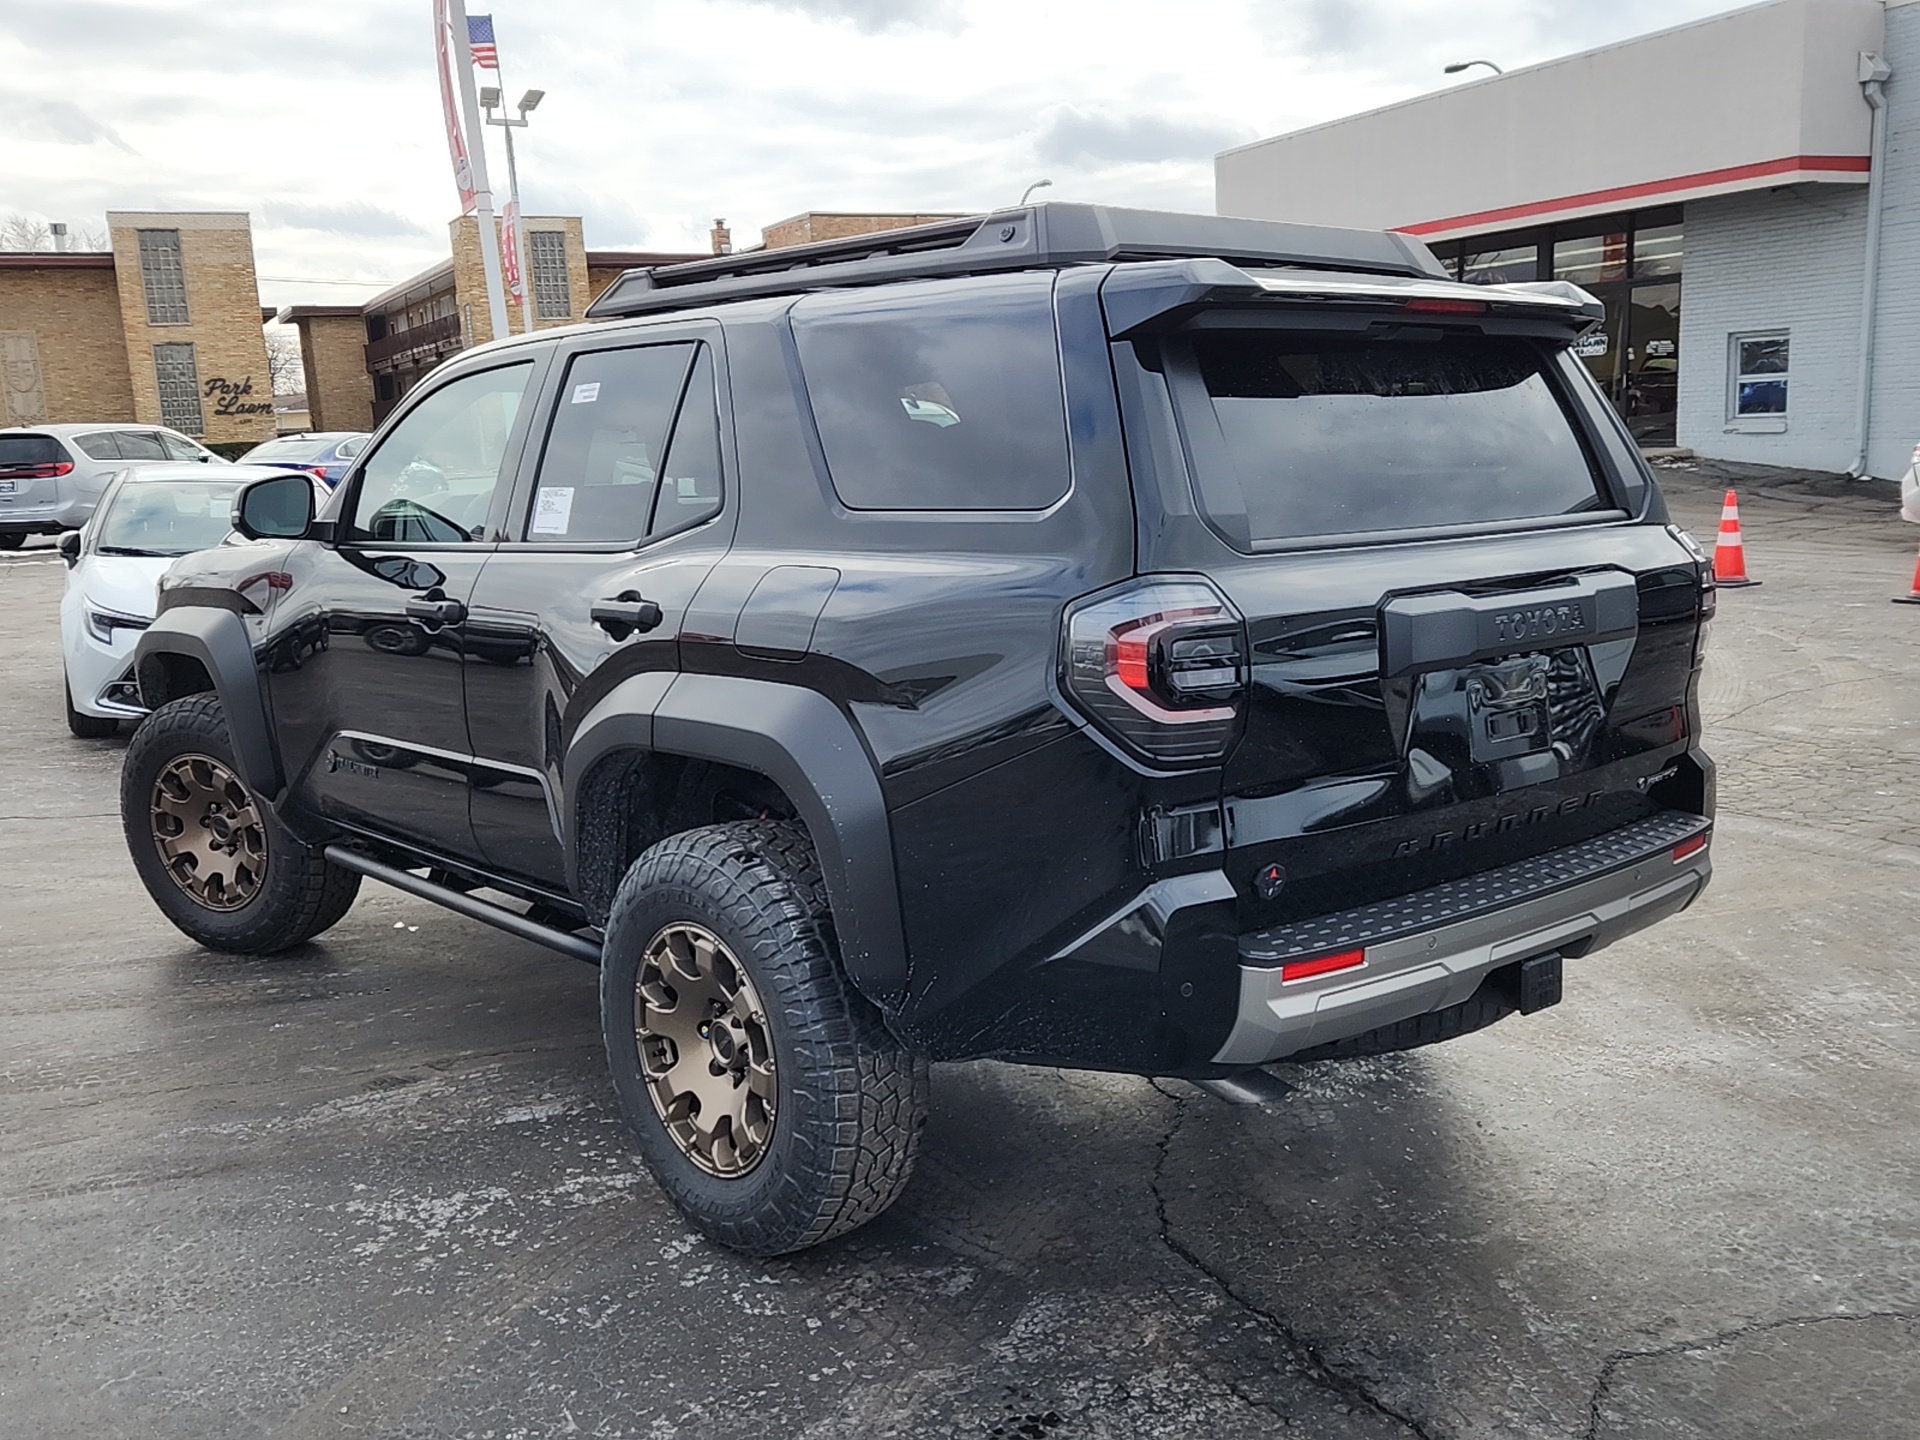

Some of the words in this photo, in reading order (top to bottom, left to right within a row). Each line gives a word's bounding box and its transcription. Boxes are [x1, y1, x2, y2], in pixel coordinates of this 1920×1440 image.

[204, 376, 252, 397] Park
[214, 396, 275, 416] Lawn
[1495, 603, 1585, 642] TOYOTA
